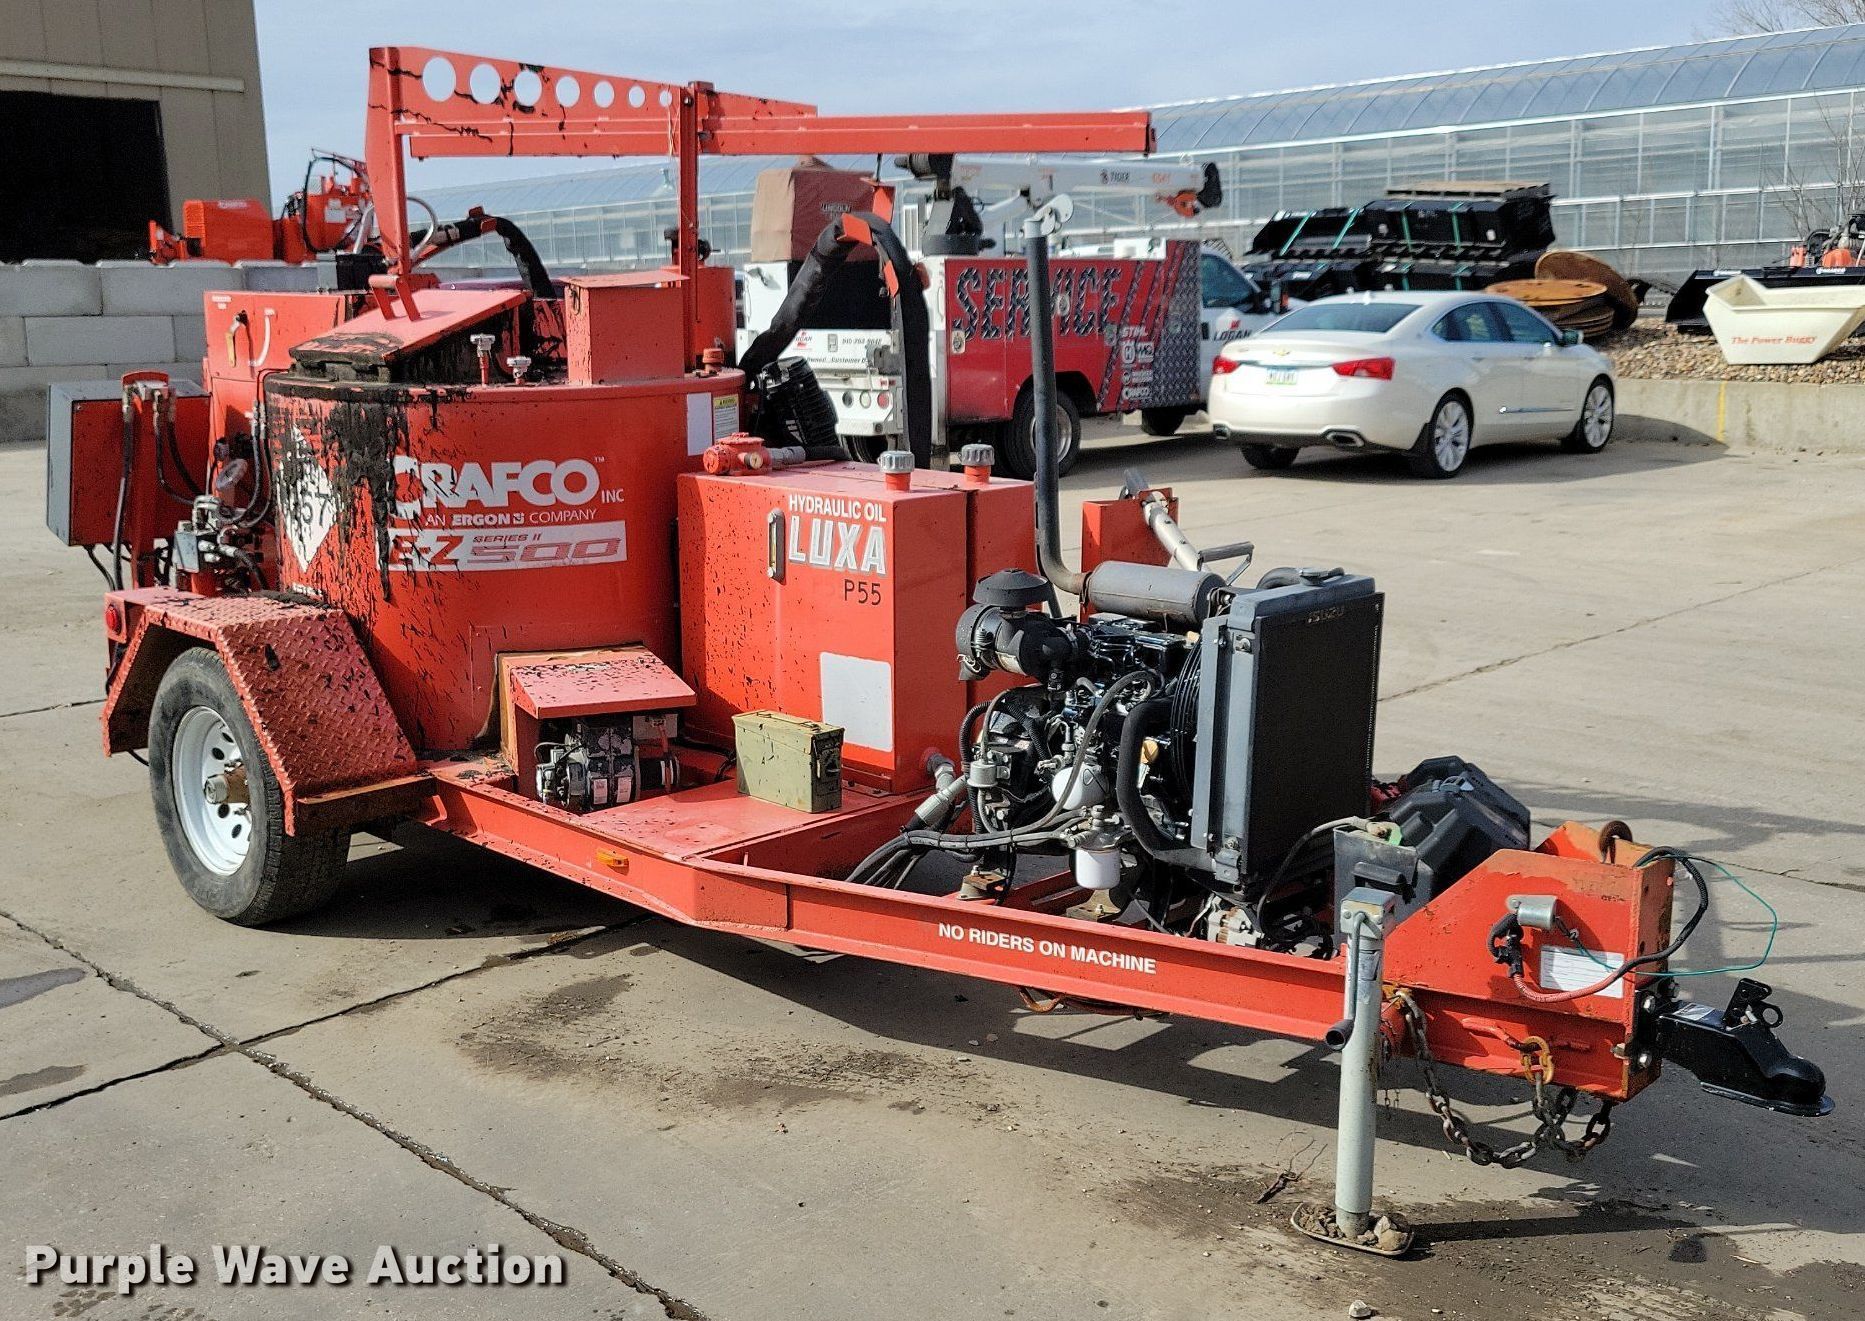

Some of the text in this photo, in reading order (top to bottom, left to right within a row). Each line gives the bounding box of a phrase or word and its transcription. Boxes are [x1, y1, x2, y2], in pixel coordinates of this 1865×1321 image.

[1731, 337, 1749, 345] The
[1750, 336, 1781, 345] Power
[391, 455, 600, 520] CRAFCO
[602, 488, 625, 504] INC
[425, 509, 597, 527] AN ERGON COMPANY
[788, 494, 887, 522] HYDRAULIC OIL
[467, 537, 622, 563] 500
[472, 534, 529, 543] SERIES
[787, 515, 888, 576] LUXA
[843, 579, 881, 606] P55
[938, 922, 1157, 974] NO RIDERS ON MACHINE
